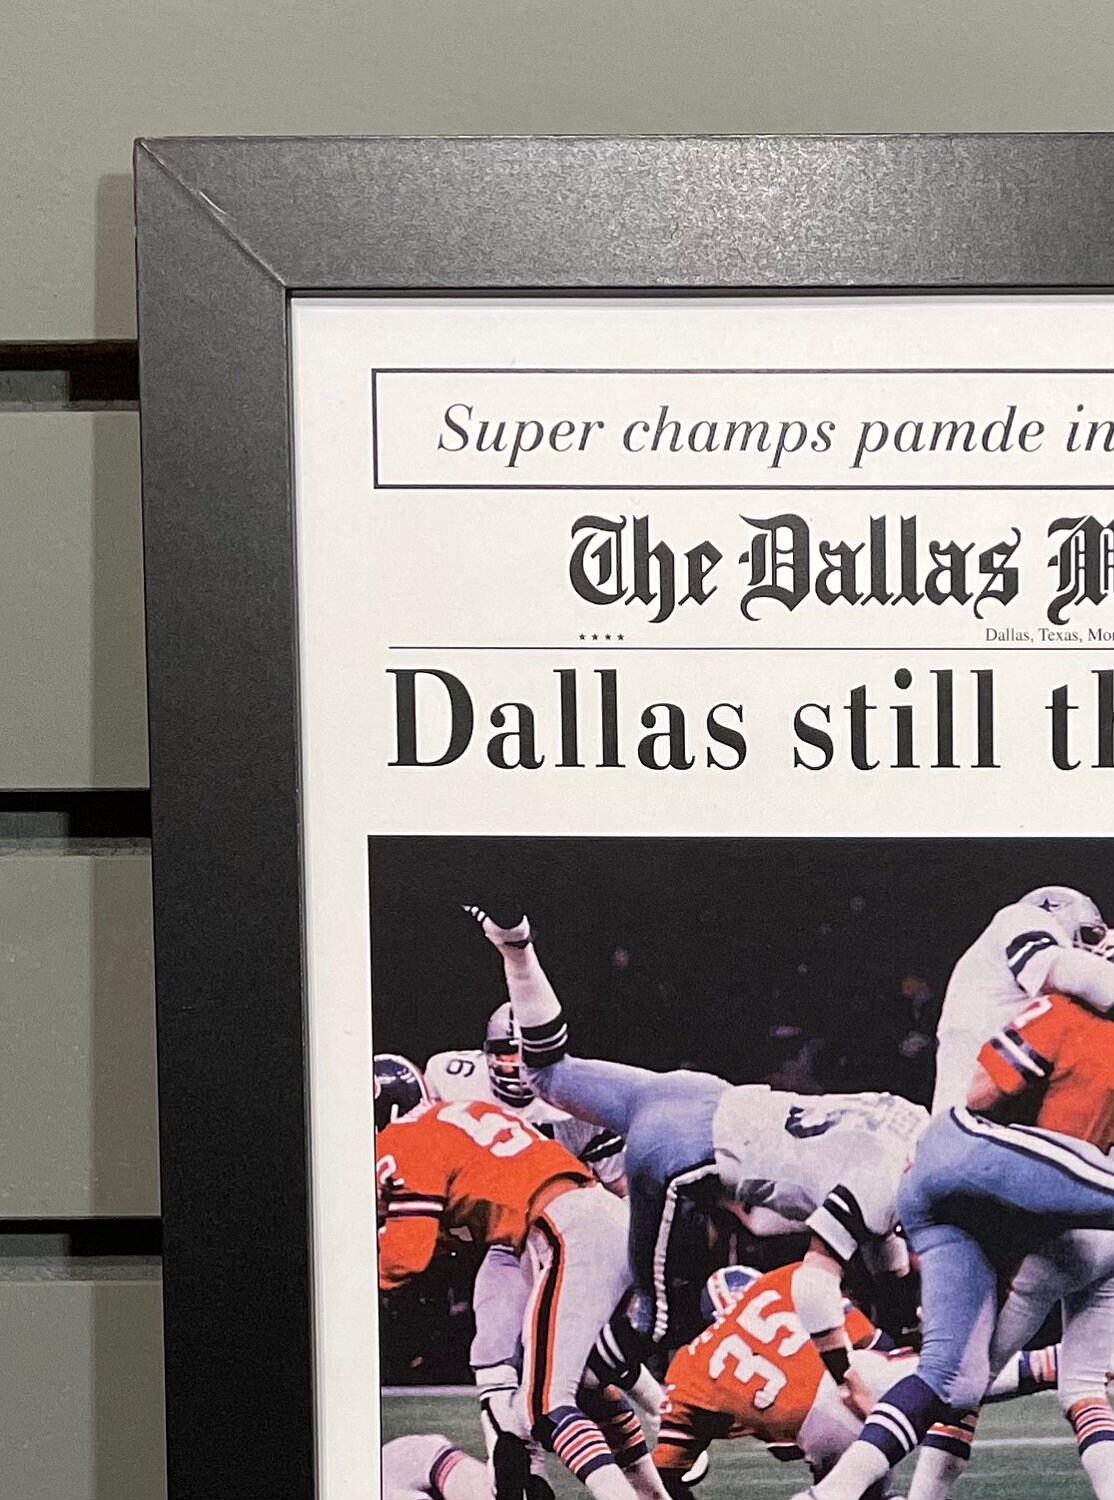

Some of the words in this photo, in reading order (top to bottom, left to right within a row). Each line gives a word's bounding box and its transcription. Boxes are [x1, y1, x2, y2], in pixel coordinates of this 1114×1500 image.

[438, 404, 604, 468] Super
[623, 406, 835, 468] champs
[850, 406, 1044, 468] pamde
[569, 515, 723, 623] The
[739, 514, 1021, 621] Dallas
[985, 627, 1034, 643] Dallas,
[1037, 627, 1083, 643] Texas,
[386, 669, 746, 770] Dallas
[794, 668, 1001, 770] still
[709, 1289, 811, 1410] 35
